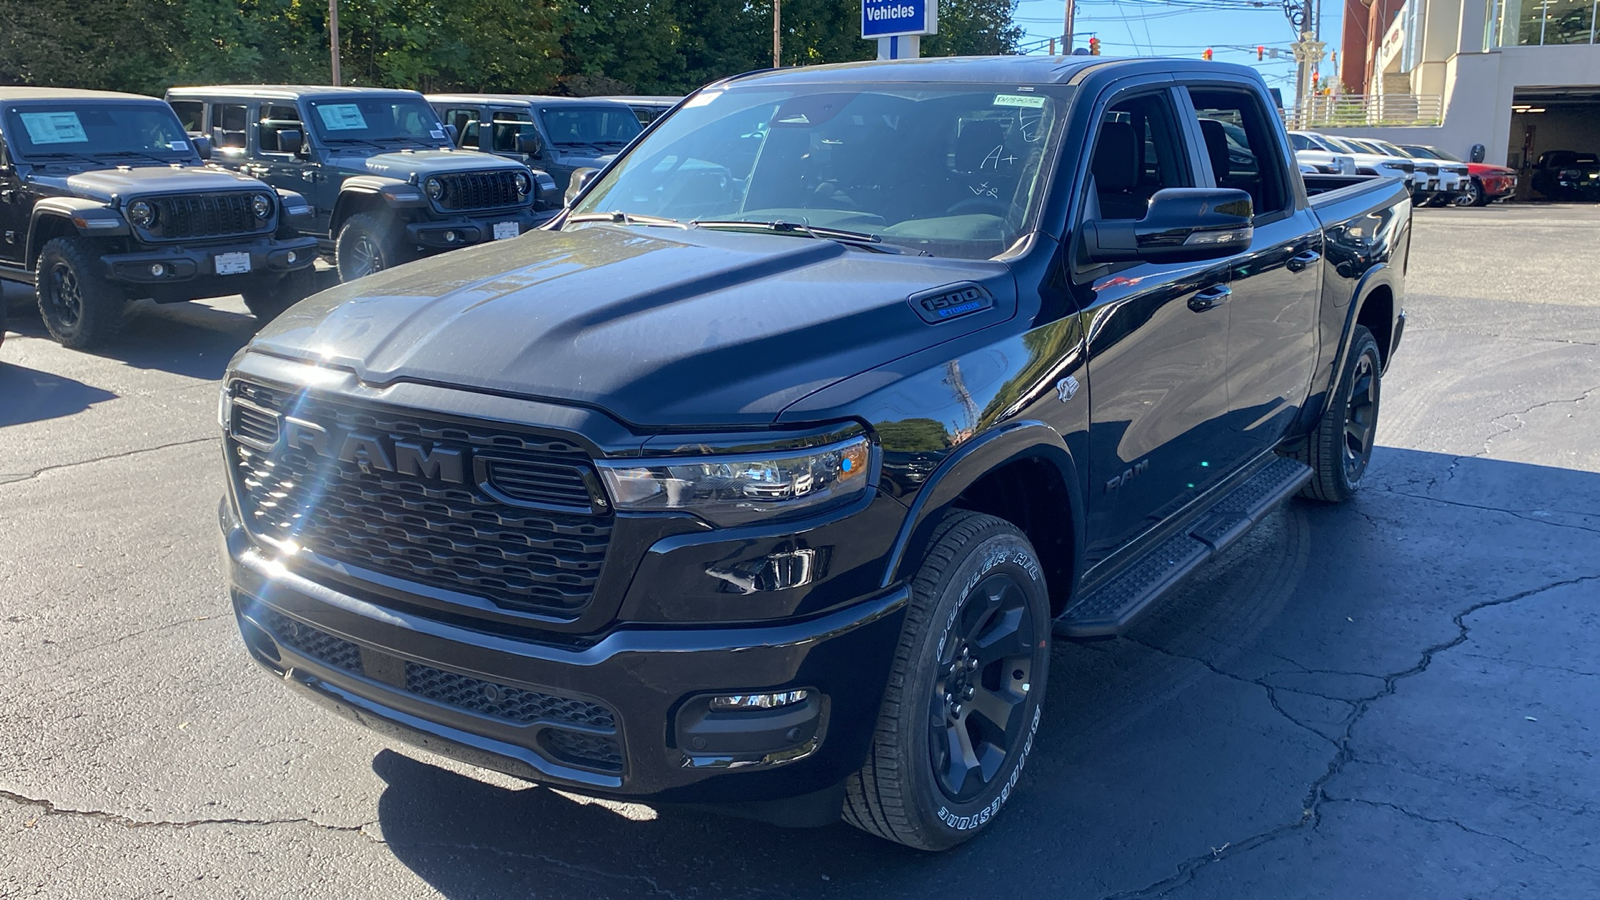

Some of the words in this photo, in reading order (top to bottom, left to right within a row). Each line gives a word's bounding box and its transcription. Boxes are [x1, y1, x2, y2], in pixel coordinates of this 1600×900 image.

[866, 4, 915, 21] Vehicles
[921, 287, 979, 311] 1500
[284, 415, 463, 484] RAM
[1103, 458, 1149, 495] RAM
[937, 703, 1041, 830] BRIDGESTONE
